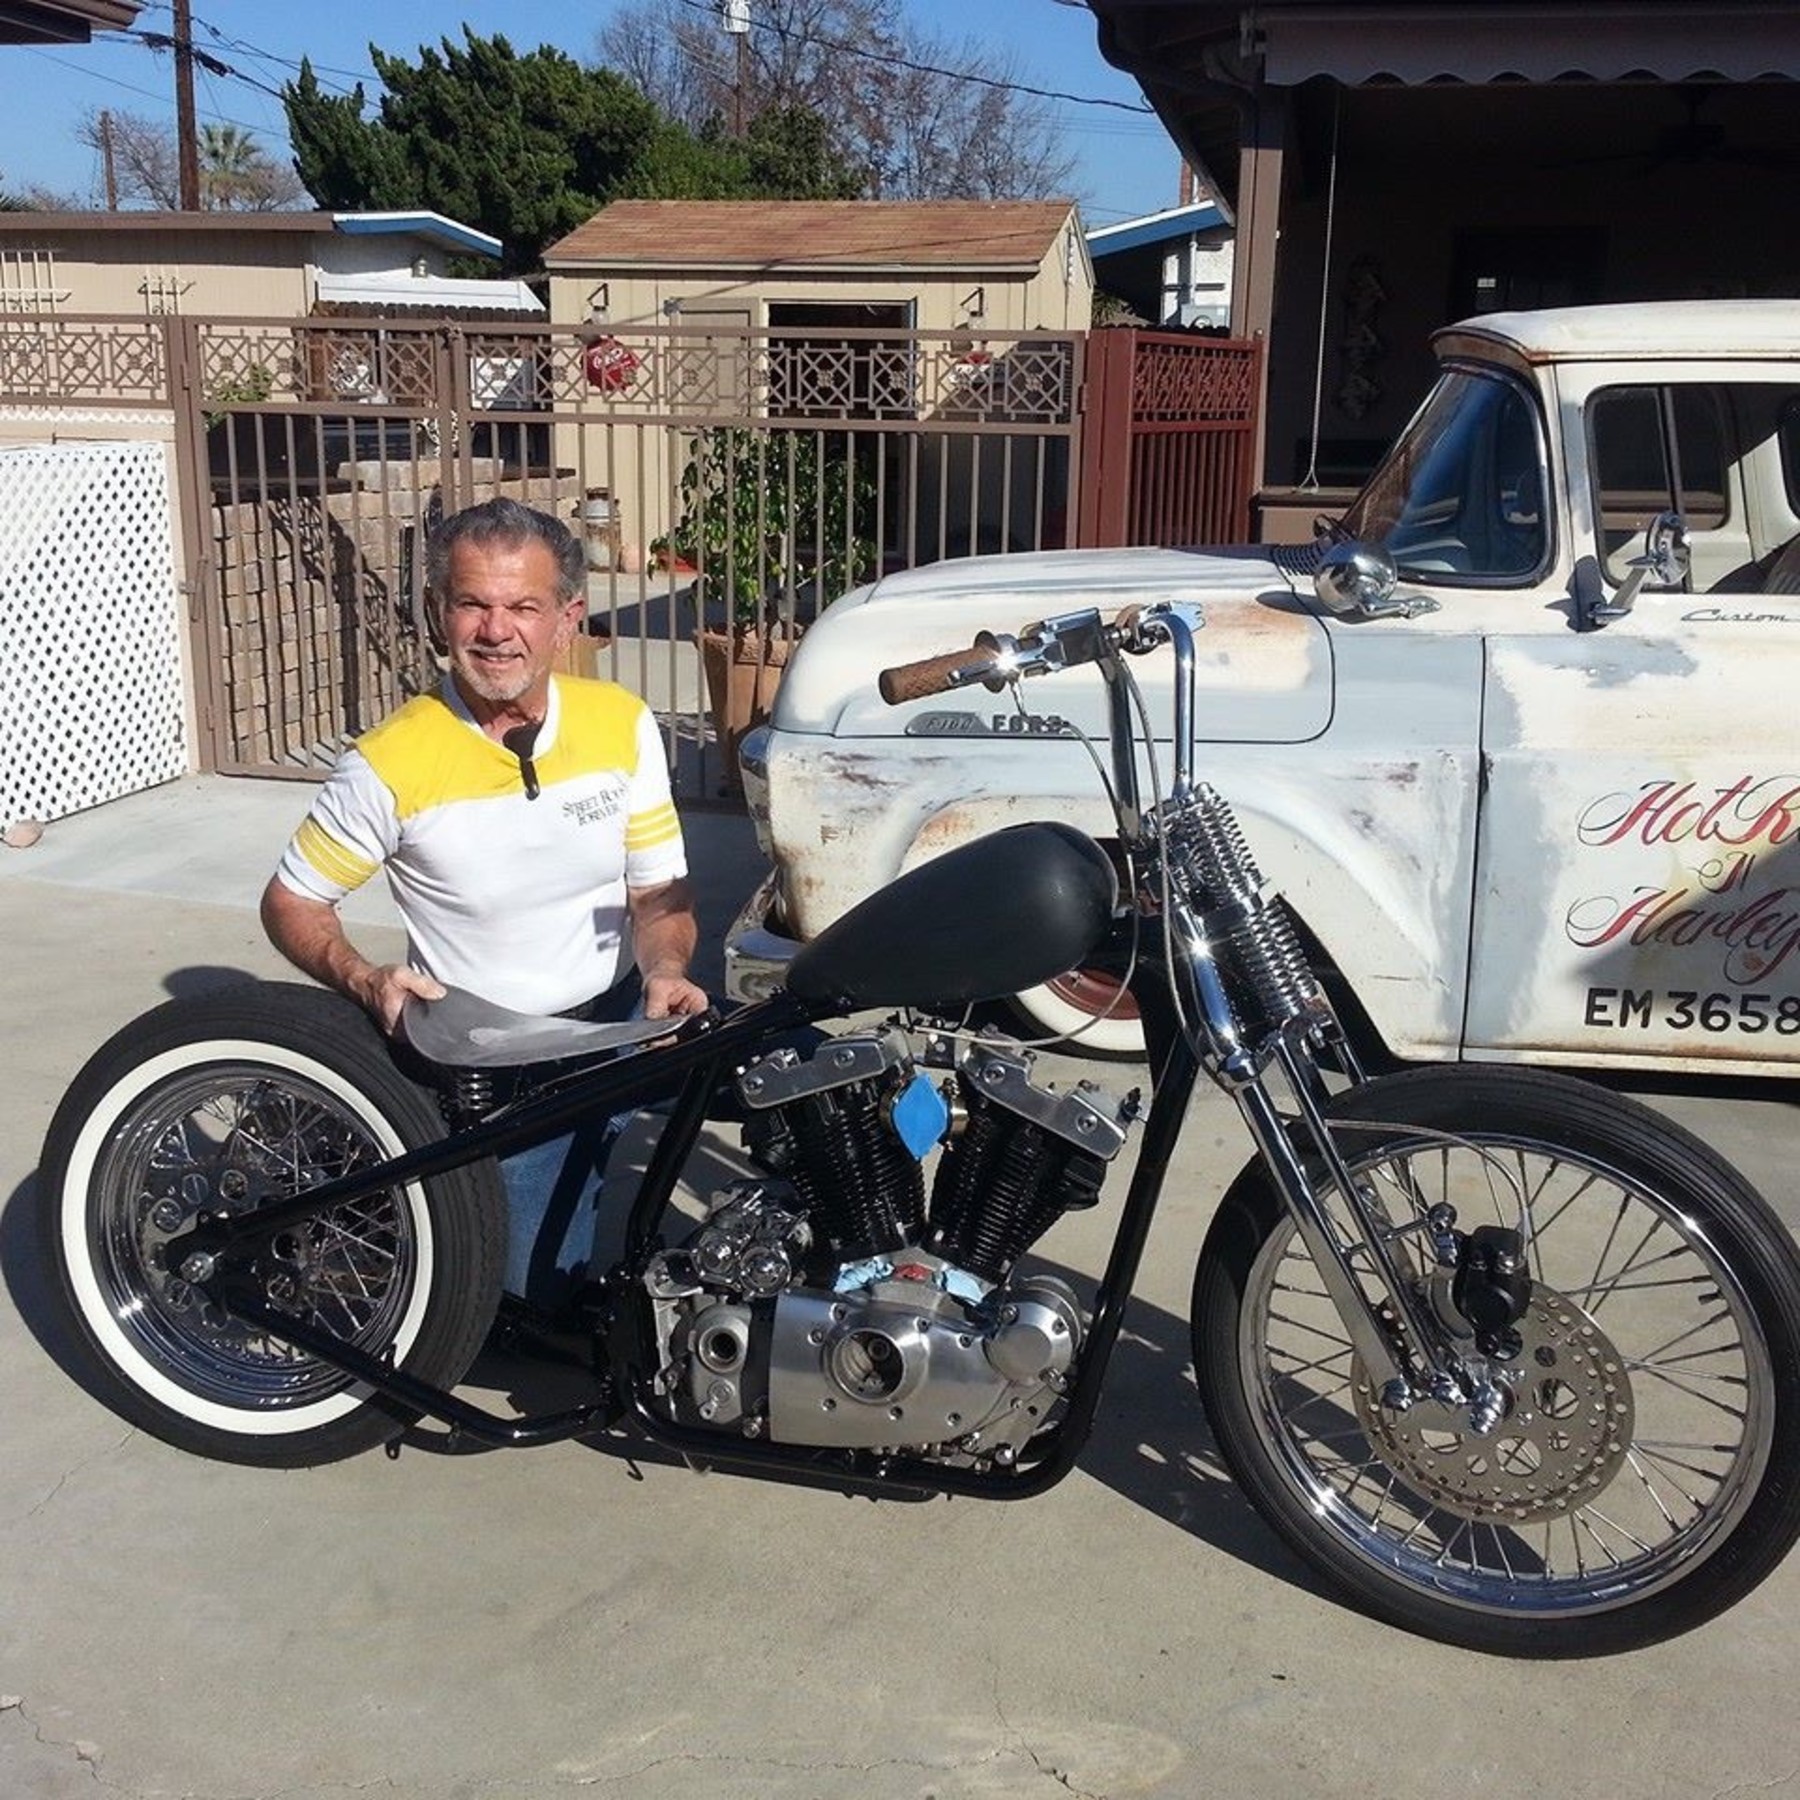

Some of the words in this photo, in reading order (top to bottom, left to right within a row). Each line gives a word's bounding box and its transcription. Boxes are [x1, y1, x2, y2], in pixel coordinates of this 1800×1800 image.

[1680, 608, 1786, 622] Custom
[1585, 987, 1653, 1029] EM
[1665, 990, 1800, 1036] 3658
